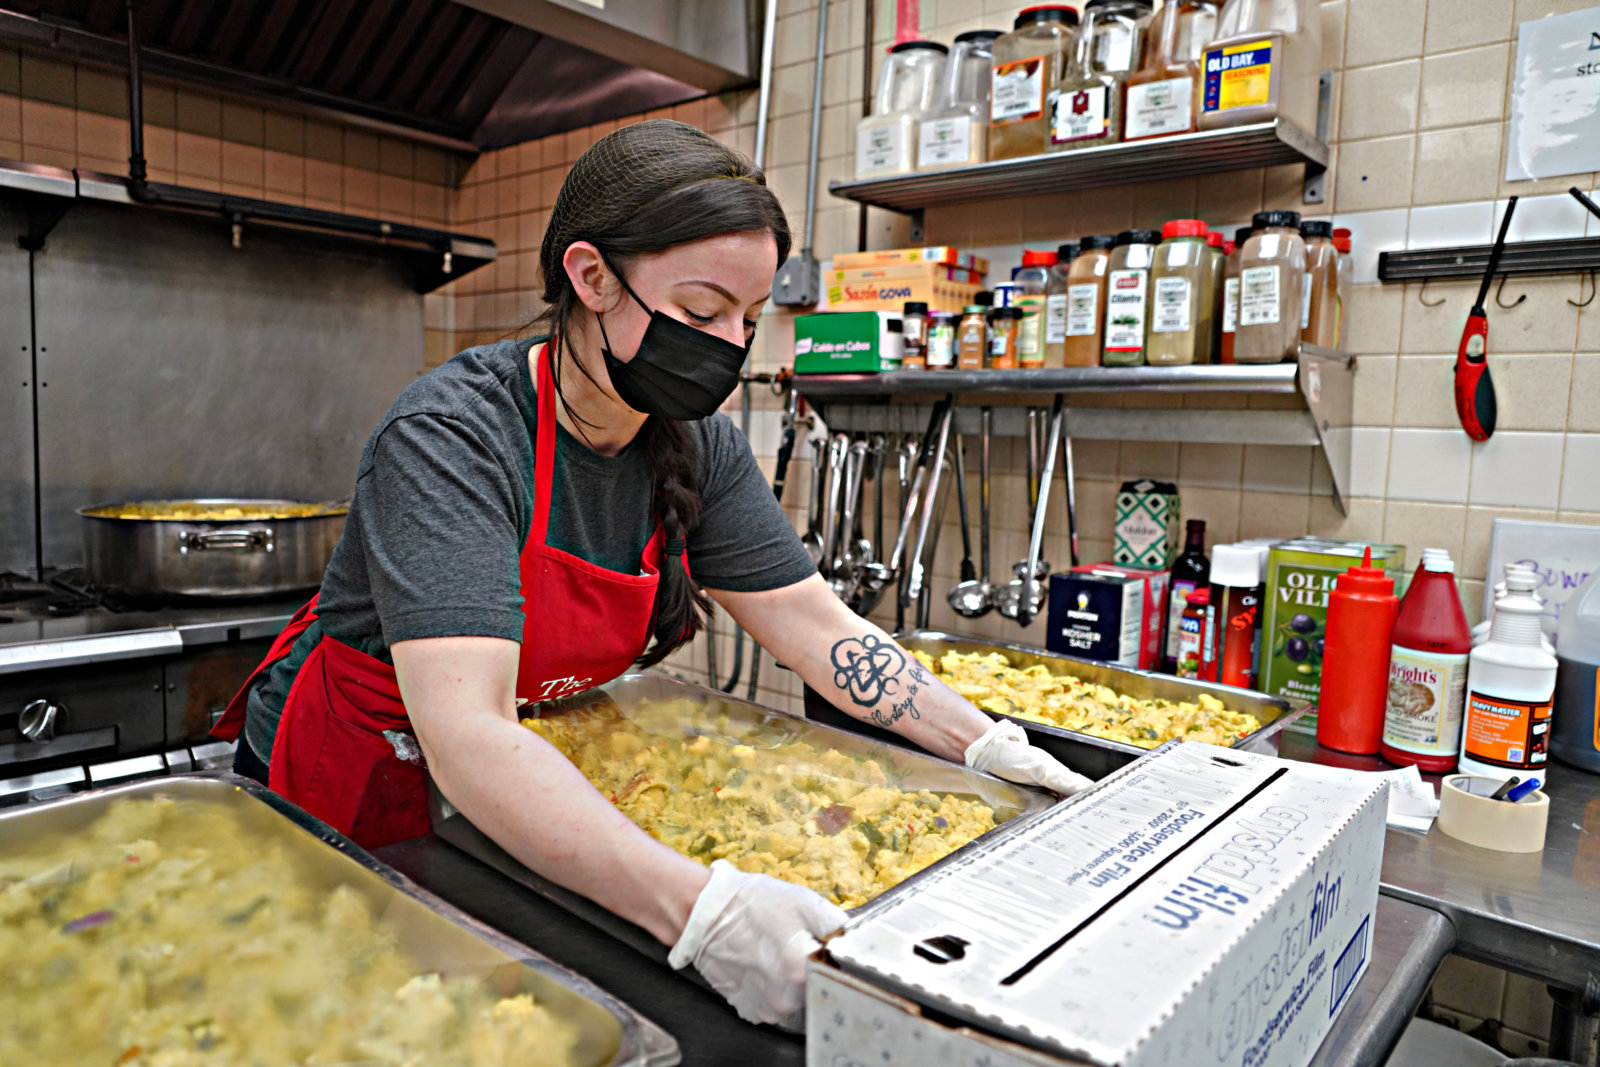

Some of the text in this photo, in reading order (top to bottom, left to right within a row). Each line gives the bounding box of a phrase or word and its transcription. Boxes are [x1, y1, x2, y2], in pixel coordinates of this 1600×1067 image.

[1208, 52, 1254, 72] OLD BAY
[1225, 67, 1266, 80] SEASONING
[879, 287, 911, 300] GOYA
[1111, 294, 1142, 304] Cilantro
[1062, 628, 1101, 642] KOSHER
[1069, 638, 1093, 650] SALT
[540, 675, 592, 697] The
[1118, 831, 1146, 848] 3,000
[1122, 809, 1206, 863] Foodservice
[1086, 847, 1122, 869] Square
[1088, 862, 1131, 888] Film
